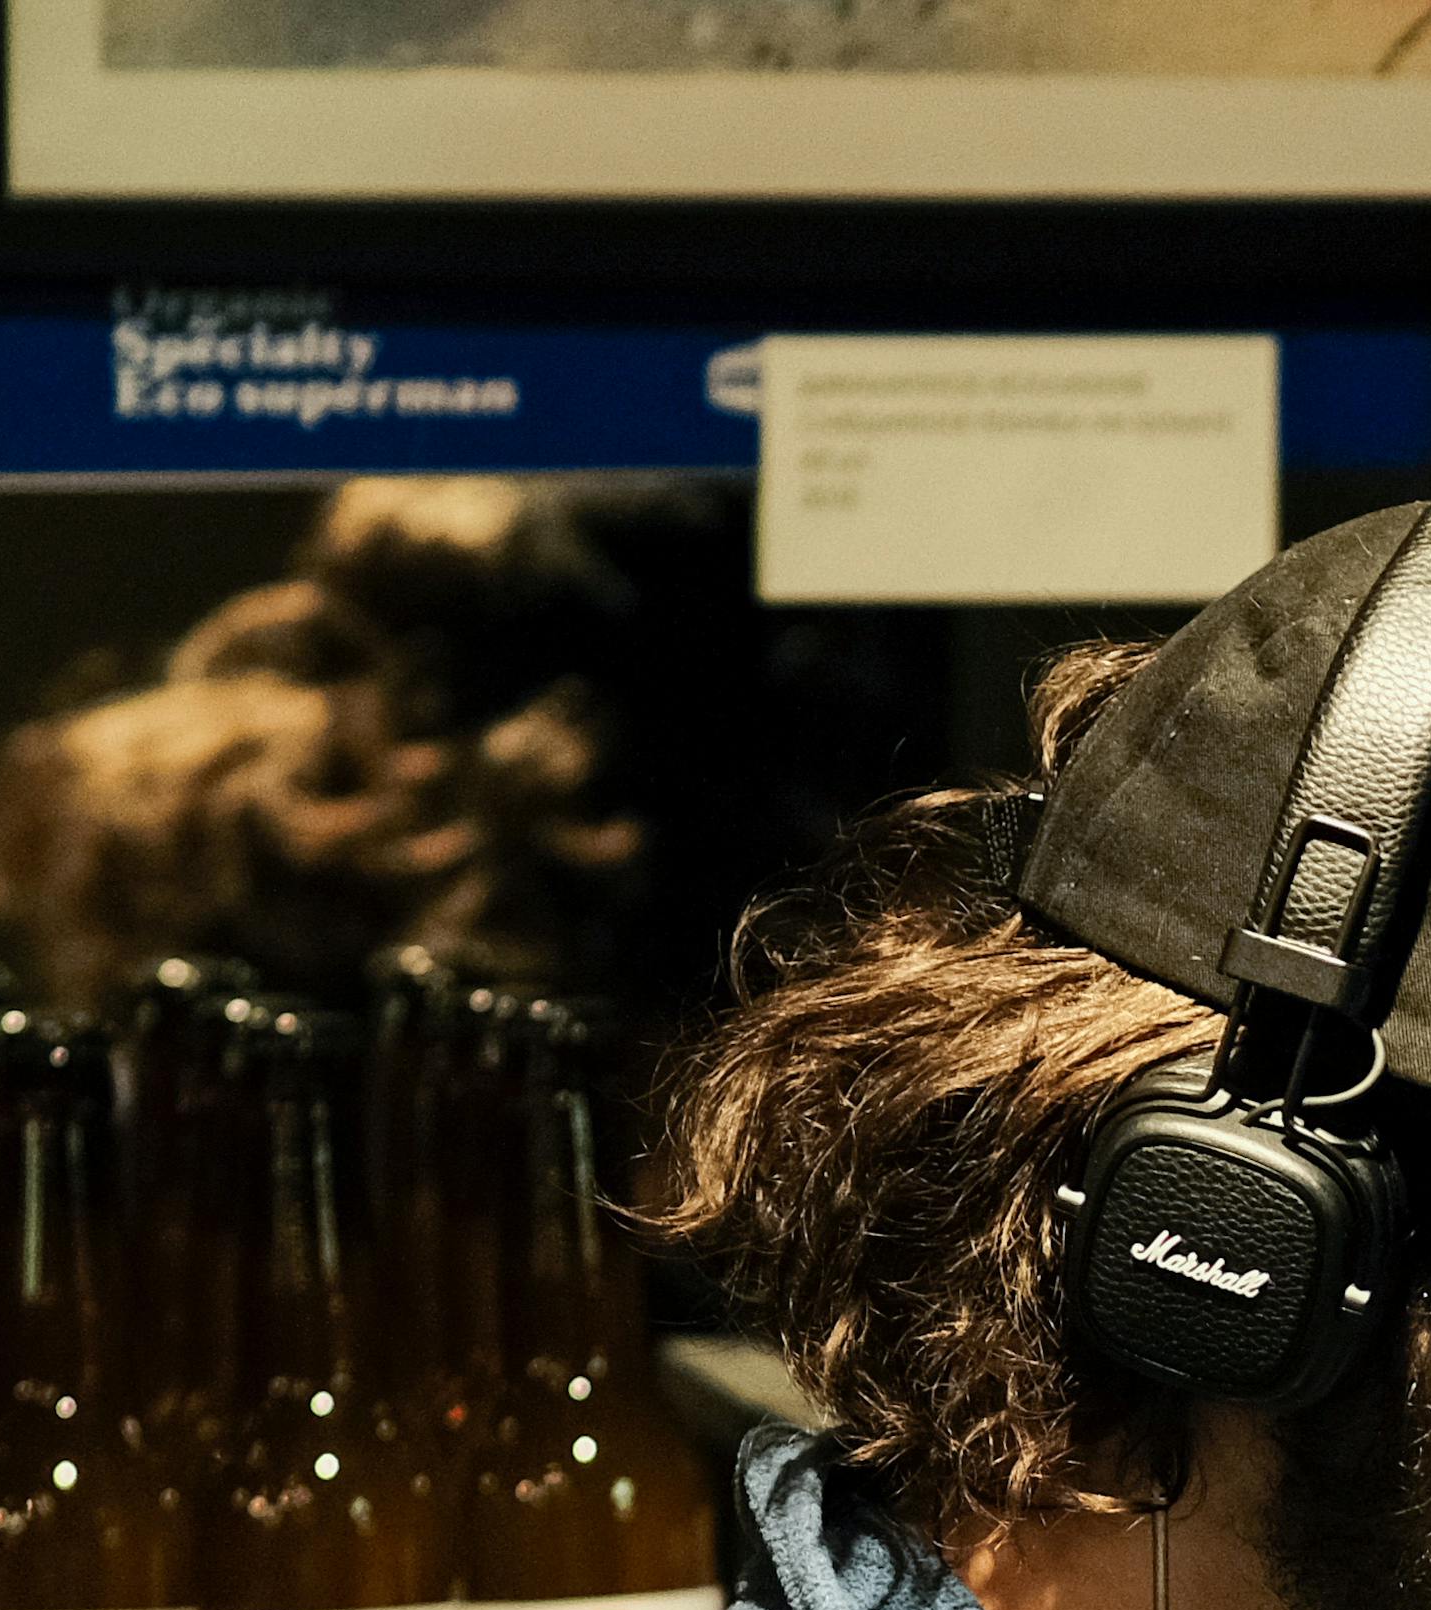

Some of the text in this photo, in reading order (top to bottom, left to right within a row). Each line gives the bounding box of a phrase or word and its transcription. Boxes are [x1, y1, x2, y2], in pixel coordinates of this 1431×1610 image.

[113, 320, 381, 380] Specialty
[114, 366, 519, 428] Eco superman
[1131, 1230, 1271, 1298] Marshall
